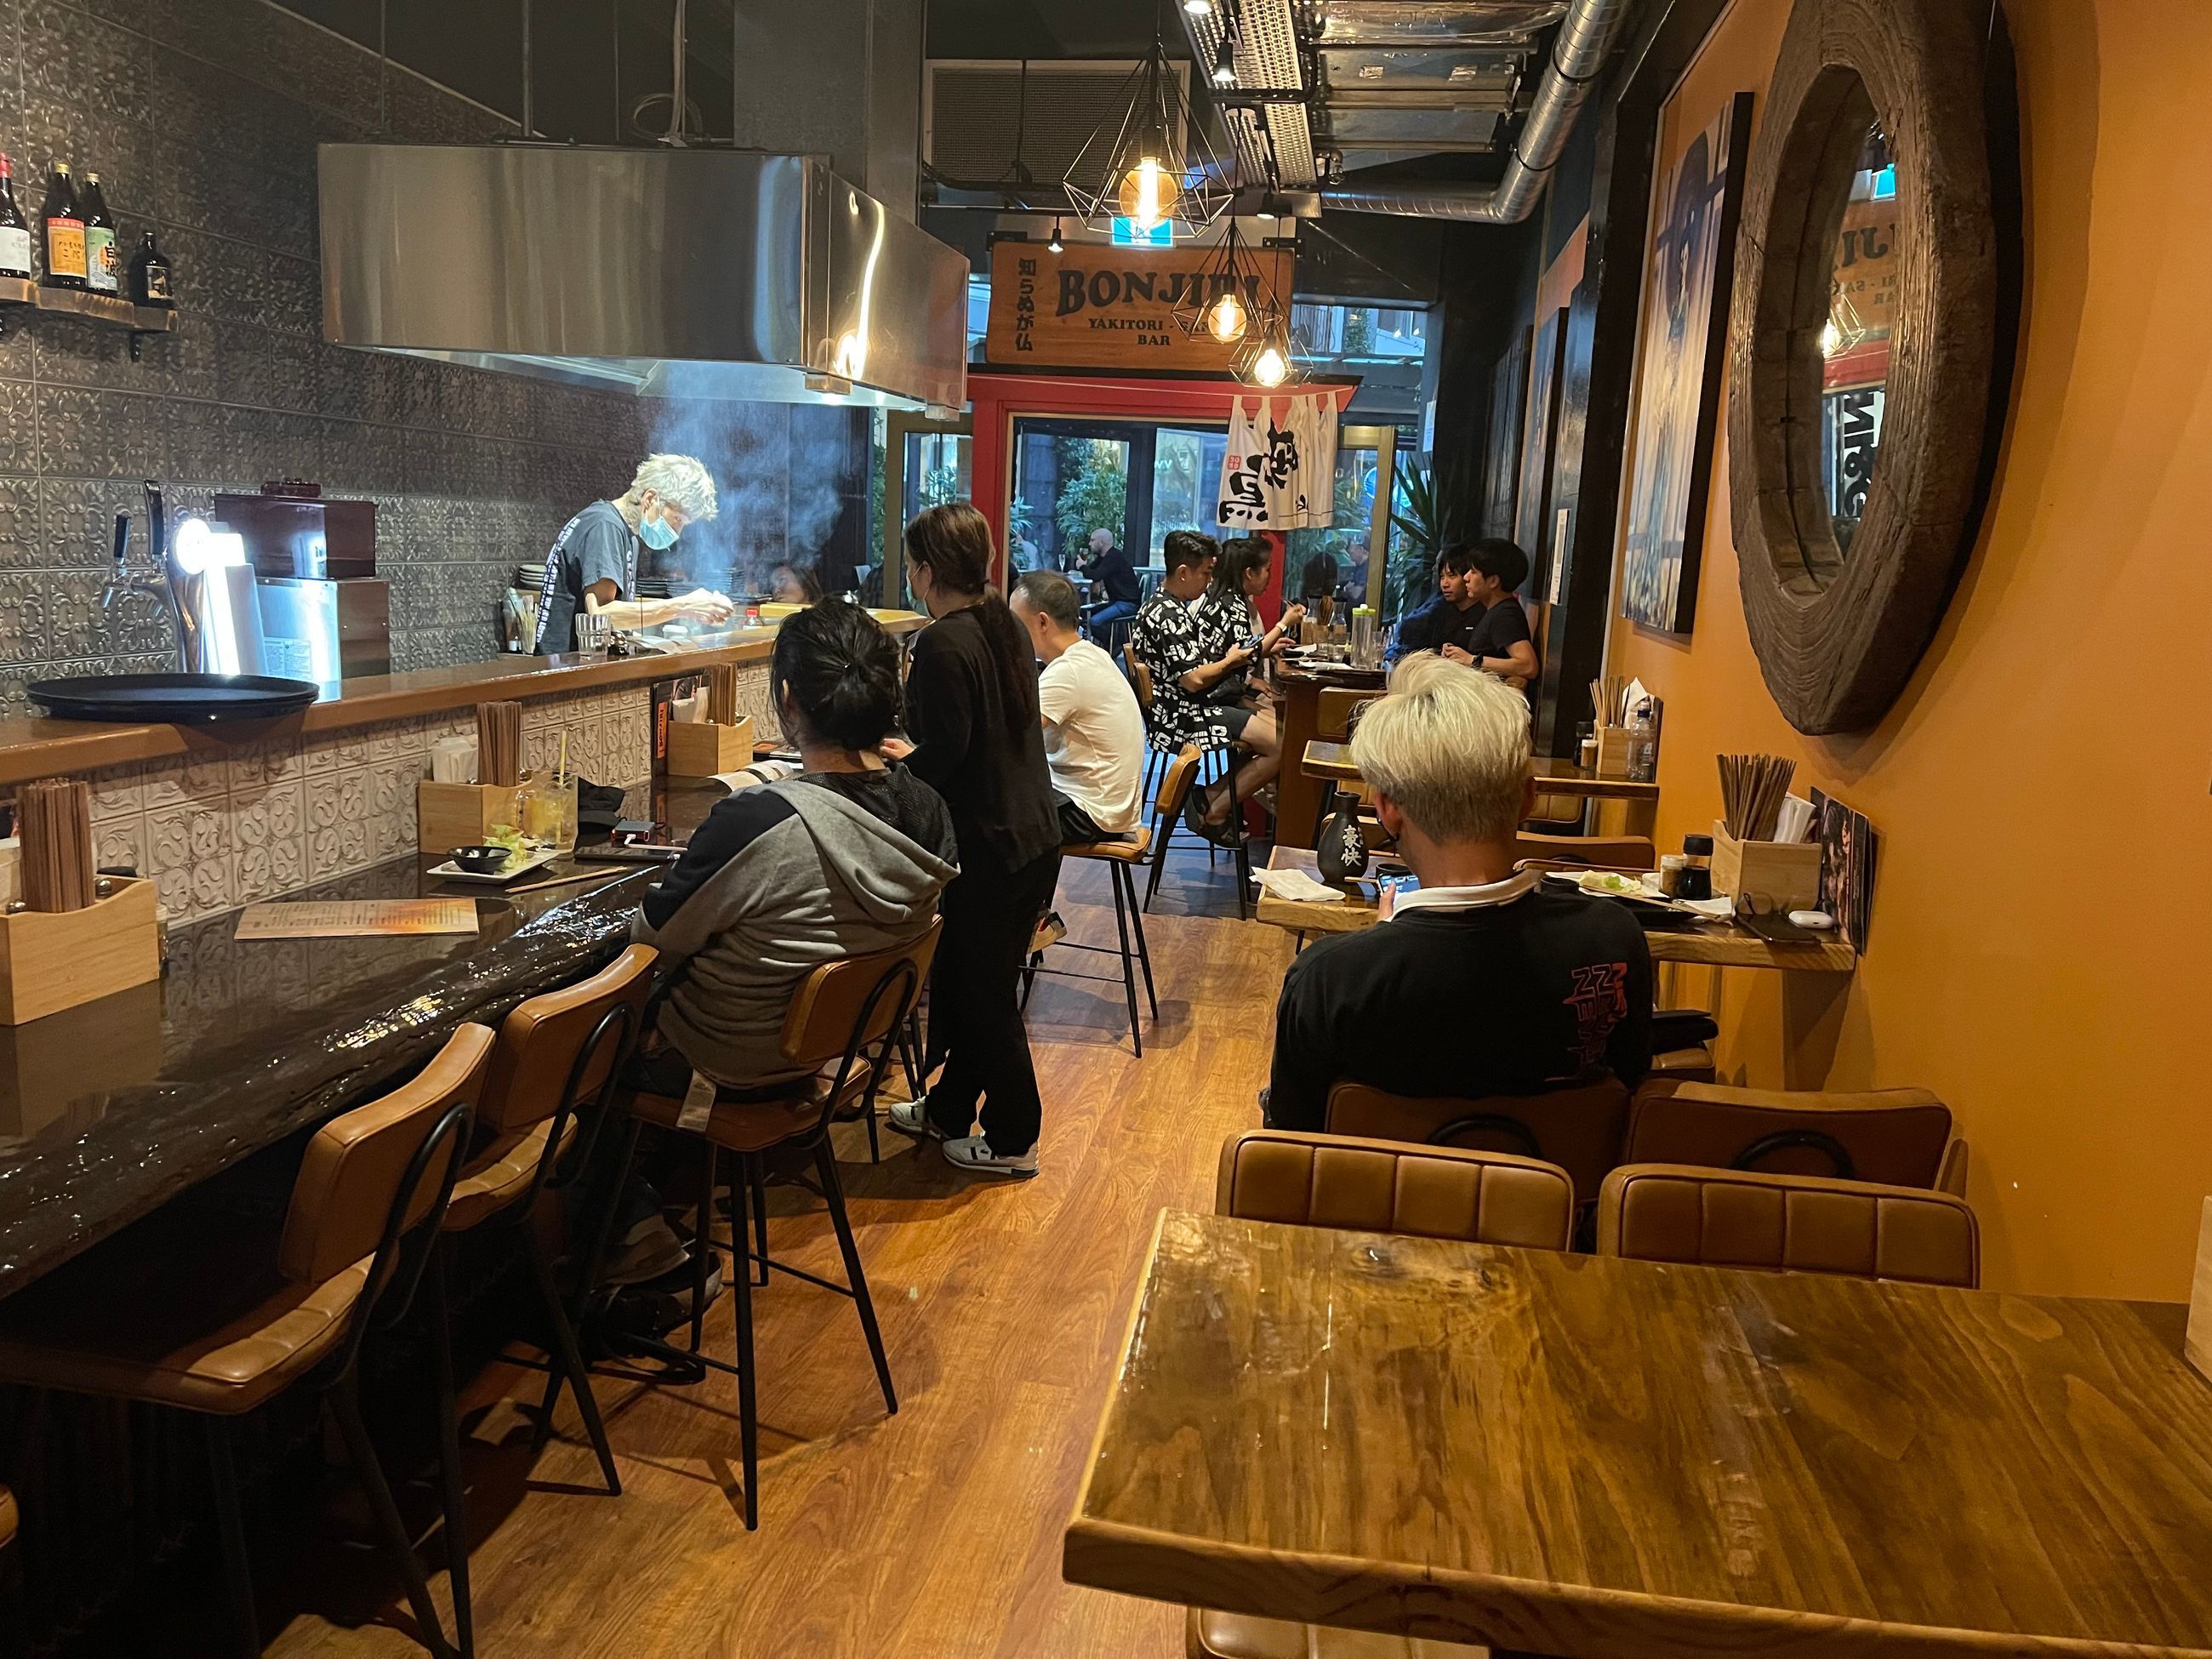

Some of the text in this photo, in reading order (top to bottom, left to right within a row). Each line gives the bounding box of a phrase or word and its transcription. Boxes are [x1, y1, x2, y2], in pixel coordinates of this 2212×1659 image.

[1088, 317, 1164, 330] YAKITORI
[1137, 334, 1171, 346] BAR
[1341, 824, 1362, 867] 豪快
